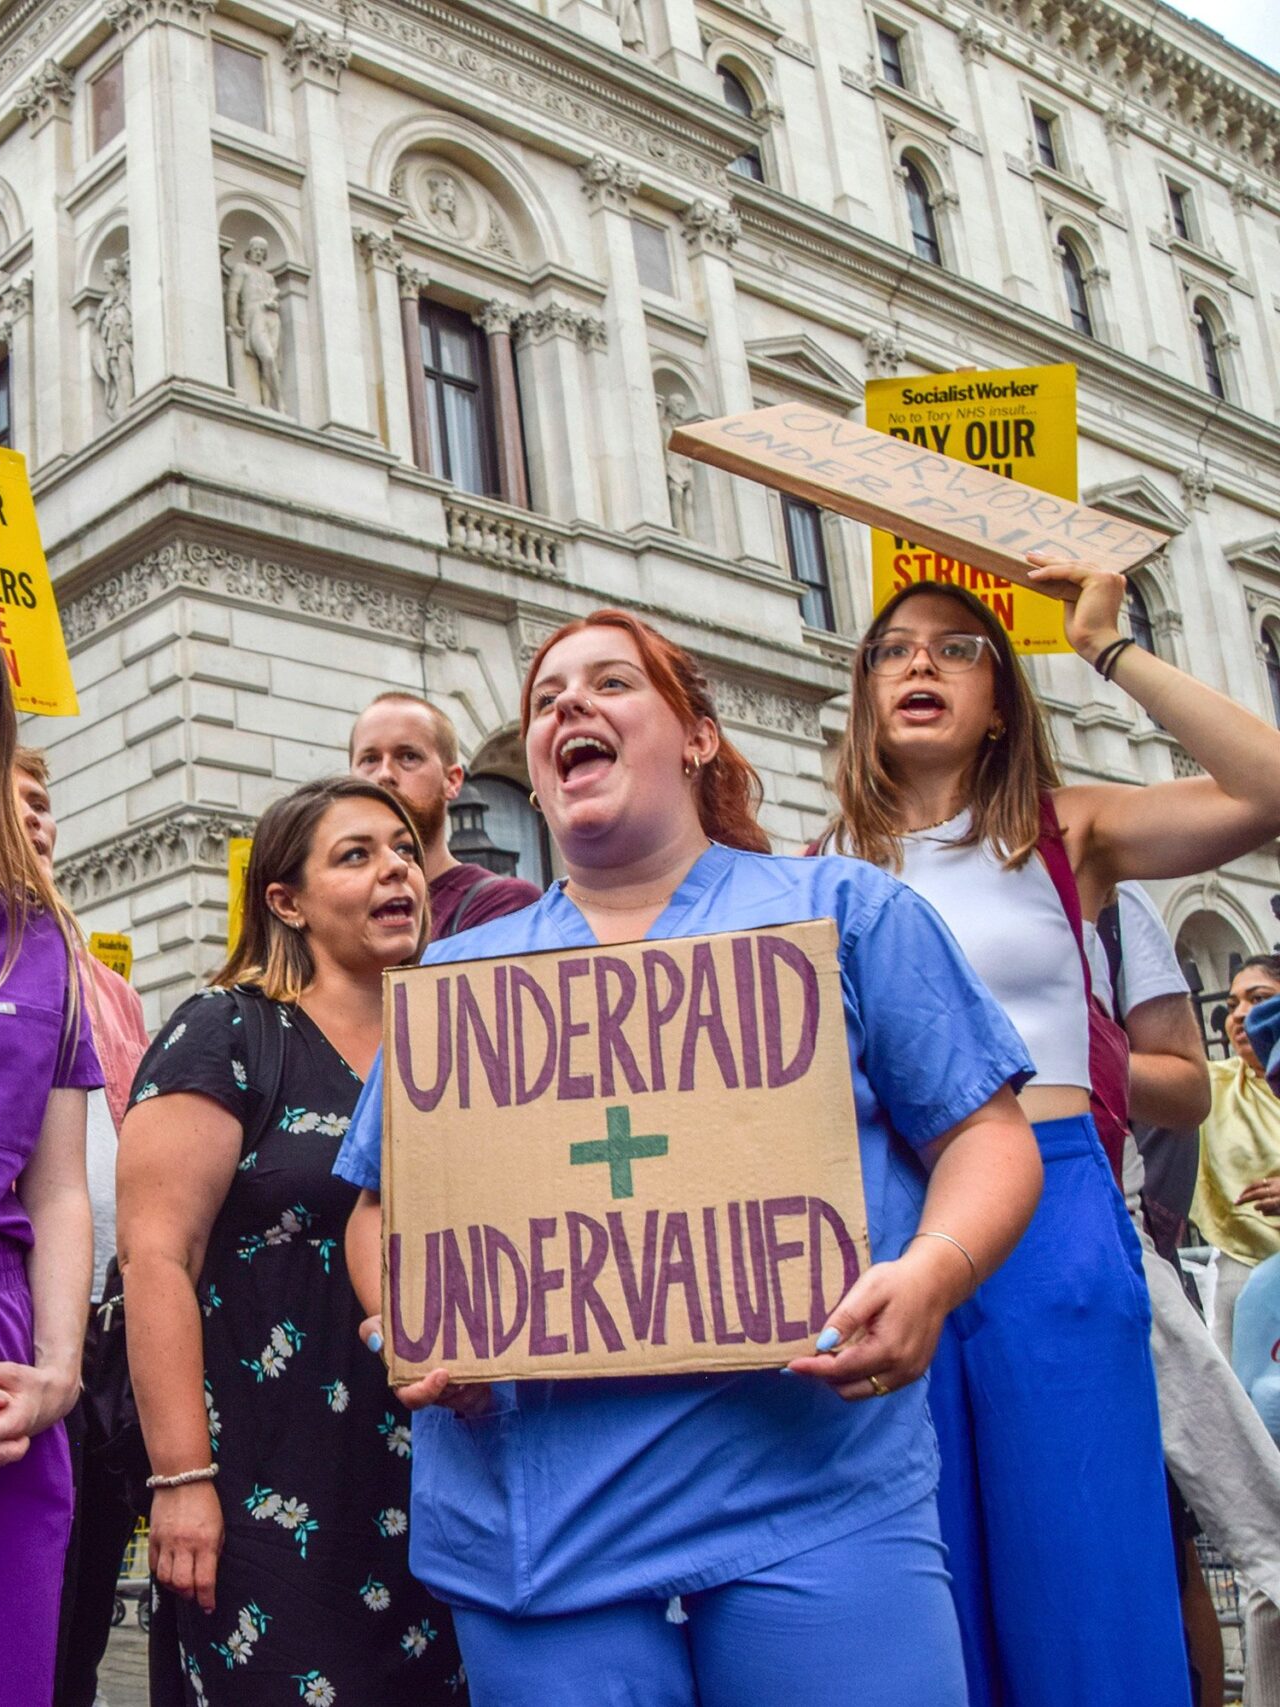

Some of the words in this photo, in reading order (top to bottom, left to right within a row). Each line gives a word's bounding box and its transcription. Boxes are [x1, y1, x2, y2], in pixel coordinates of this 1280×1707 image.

[888, 413, 906, 424] No
[910, 412, 923, 423] to
[927, 409, 952, 423] Tory
[956, 406, 986, 419] NHS
[902, 385, 974, 405] Socialist
[976, 381, 1038, 399] Worker
[782, 413, 1158, 555] OVERWORKED
[965, 419, 1036, 460] OUR
[394, 935, 820, 1112] UNDERPAID
[388, 1196, 861, 1364] UNDERVALUED
